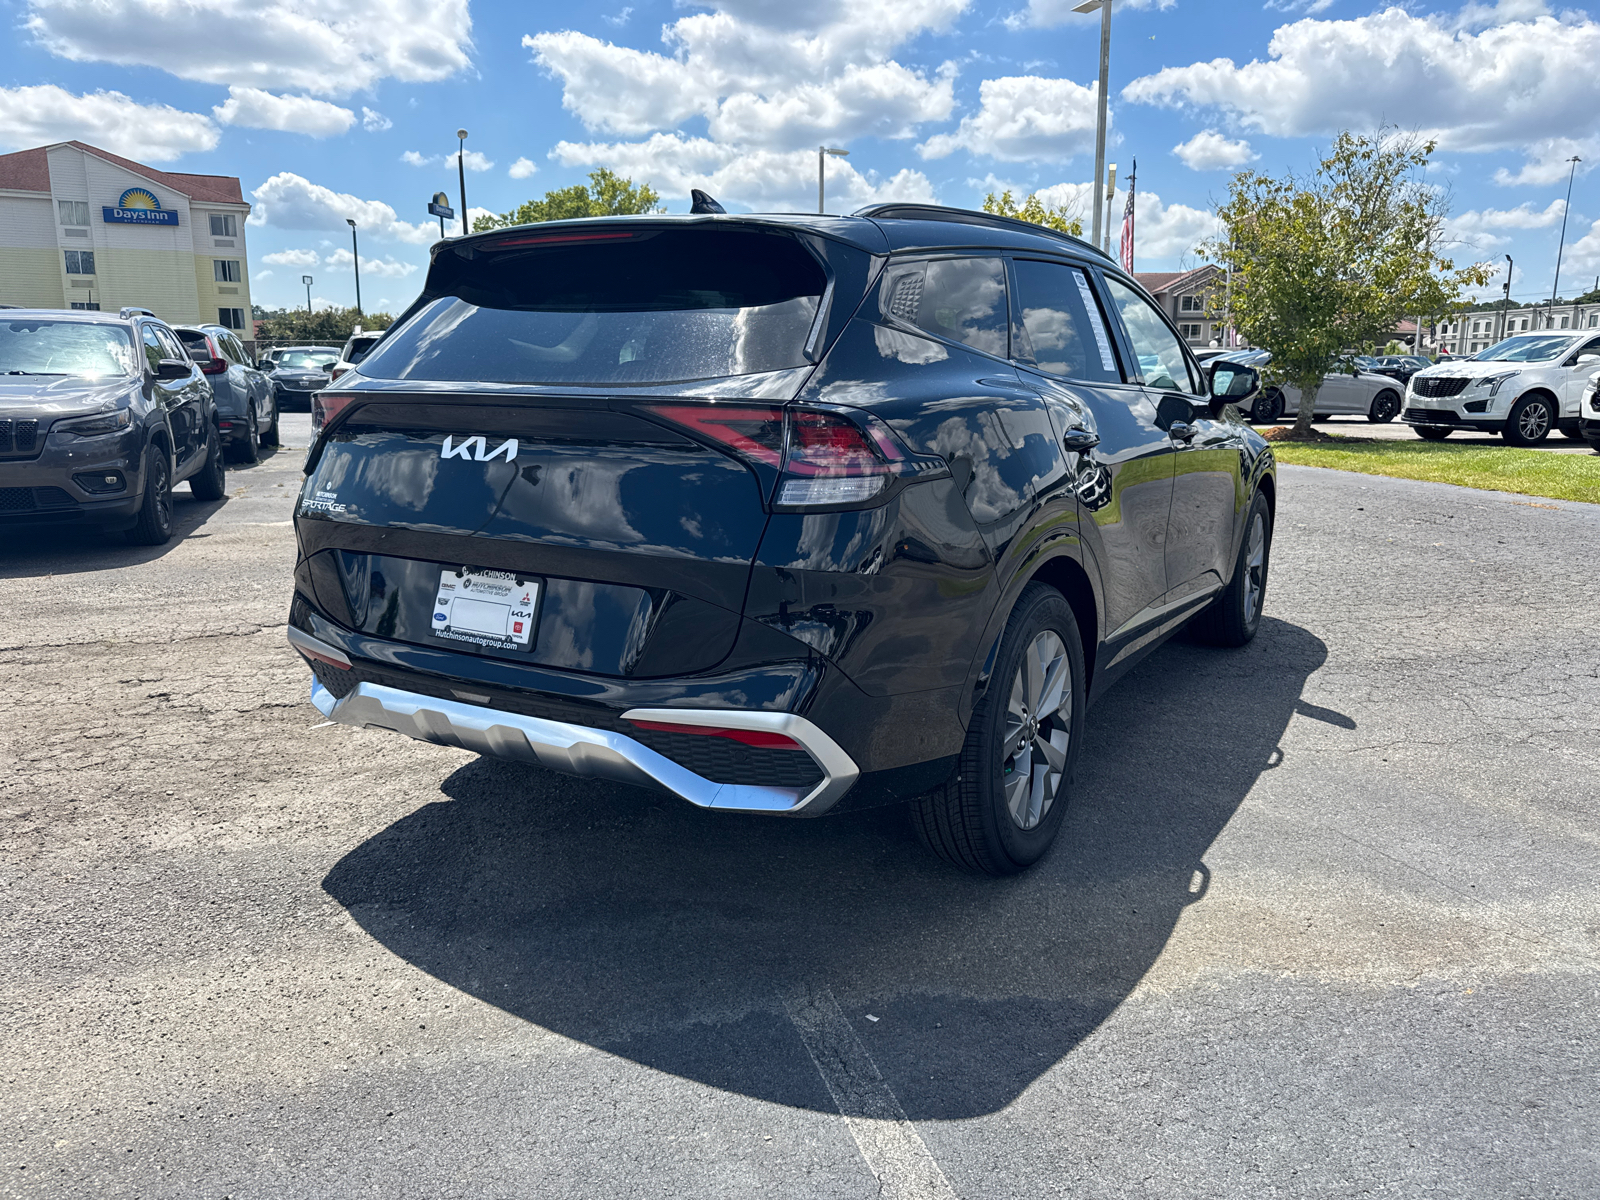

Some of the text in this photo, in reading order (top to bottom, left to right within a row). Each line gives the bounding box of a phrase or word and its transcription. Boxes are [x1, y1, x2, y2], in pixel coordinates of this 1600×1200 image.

[113, 209, 168, 220] Days Inn
[441, 434, 519, 464] KIA
[301, 499, 347, 513] SPORTAGE
[471, 569, 517, 582] TCHINSON
[435, 629, 518, 650] Hutchinsonautogroup.com
